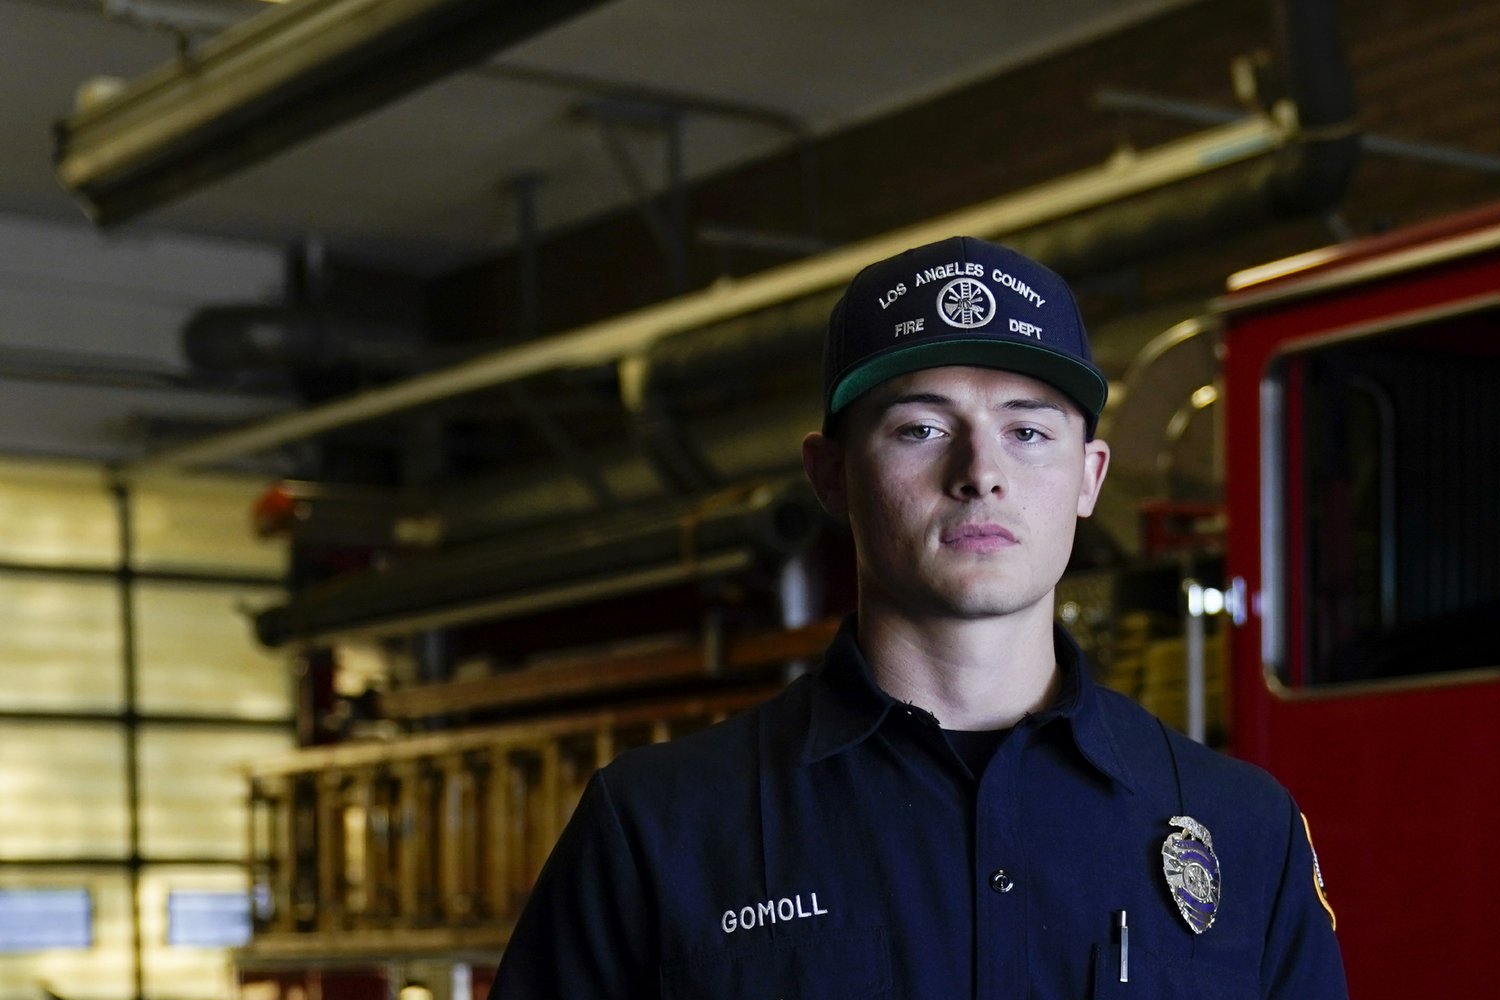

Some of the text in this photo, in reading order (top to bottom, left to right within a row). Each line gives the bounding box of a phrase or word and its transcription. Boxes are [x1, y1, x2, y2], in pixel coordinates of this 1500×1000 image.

[879, 262, 1046, 310] LOS ANGELES COUNTY
[894, 318, 925, 337] FIRE
[1009, 318, 1042, 340] DEPT
[722, 893, 828, 933] GOMOLL
